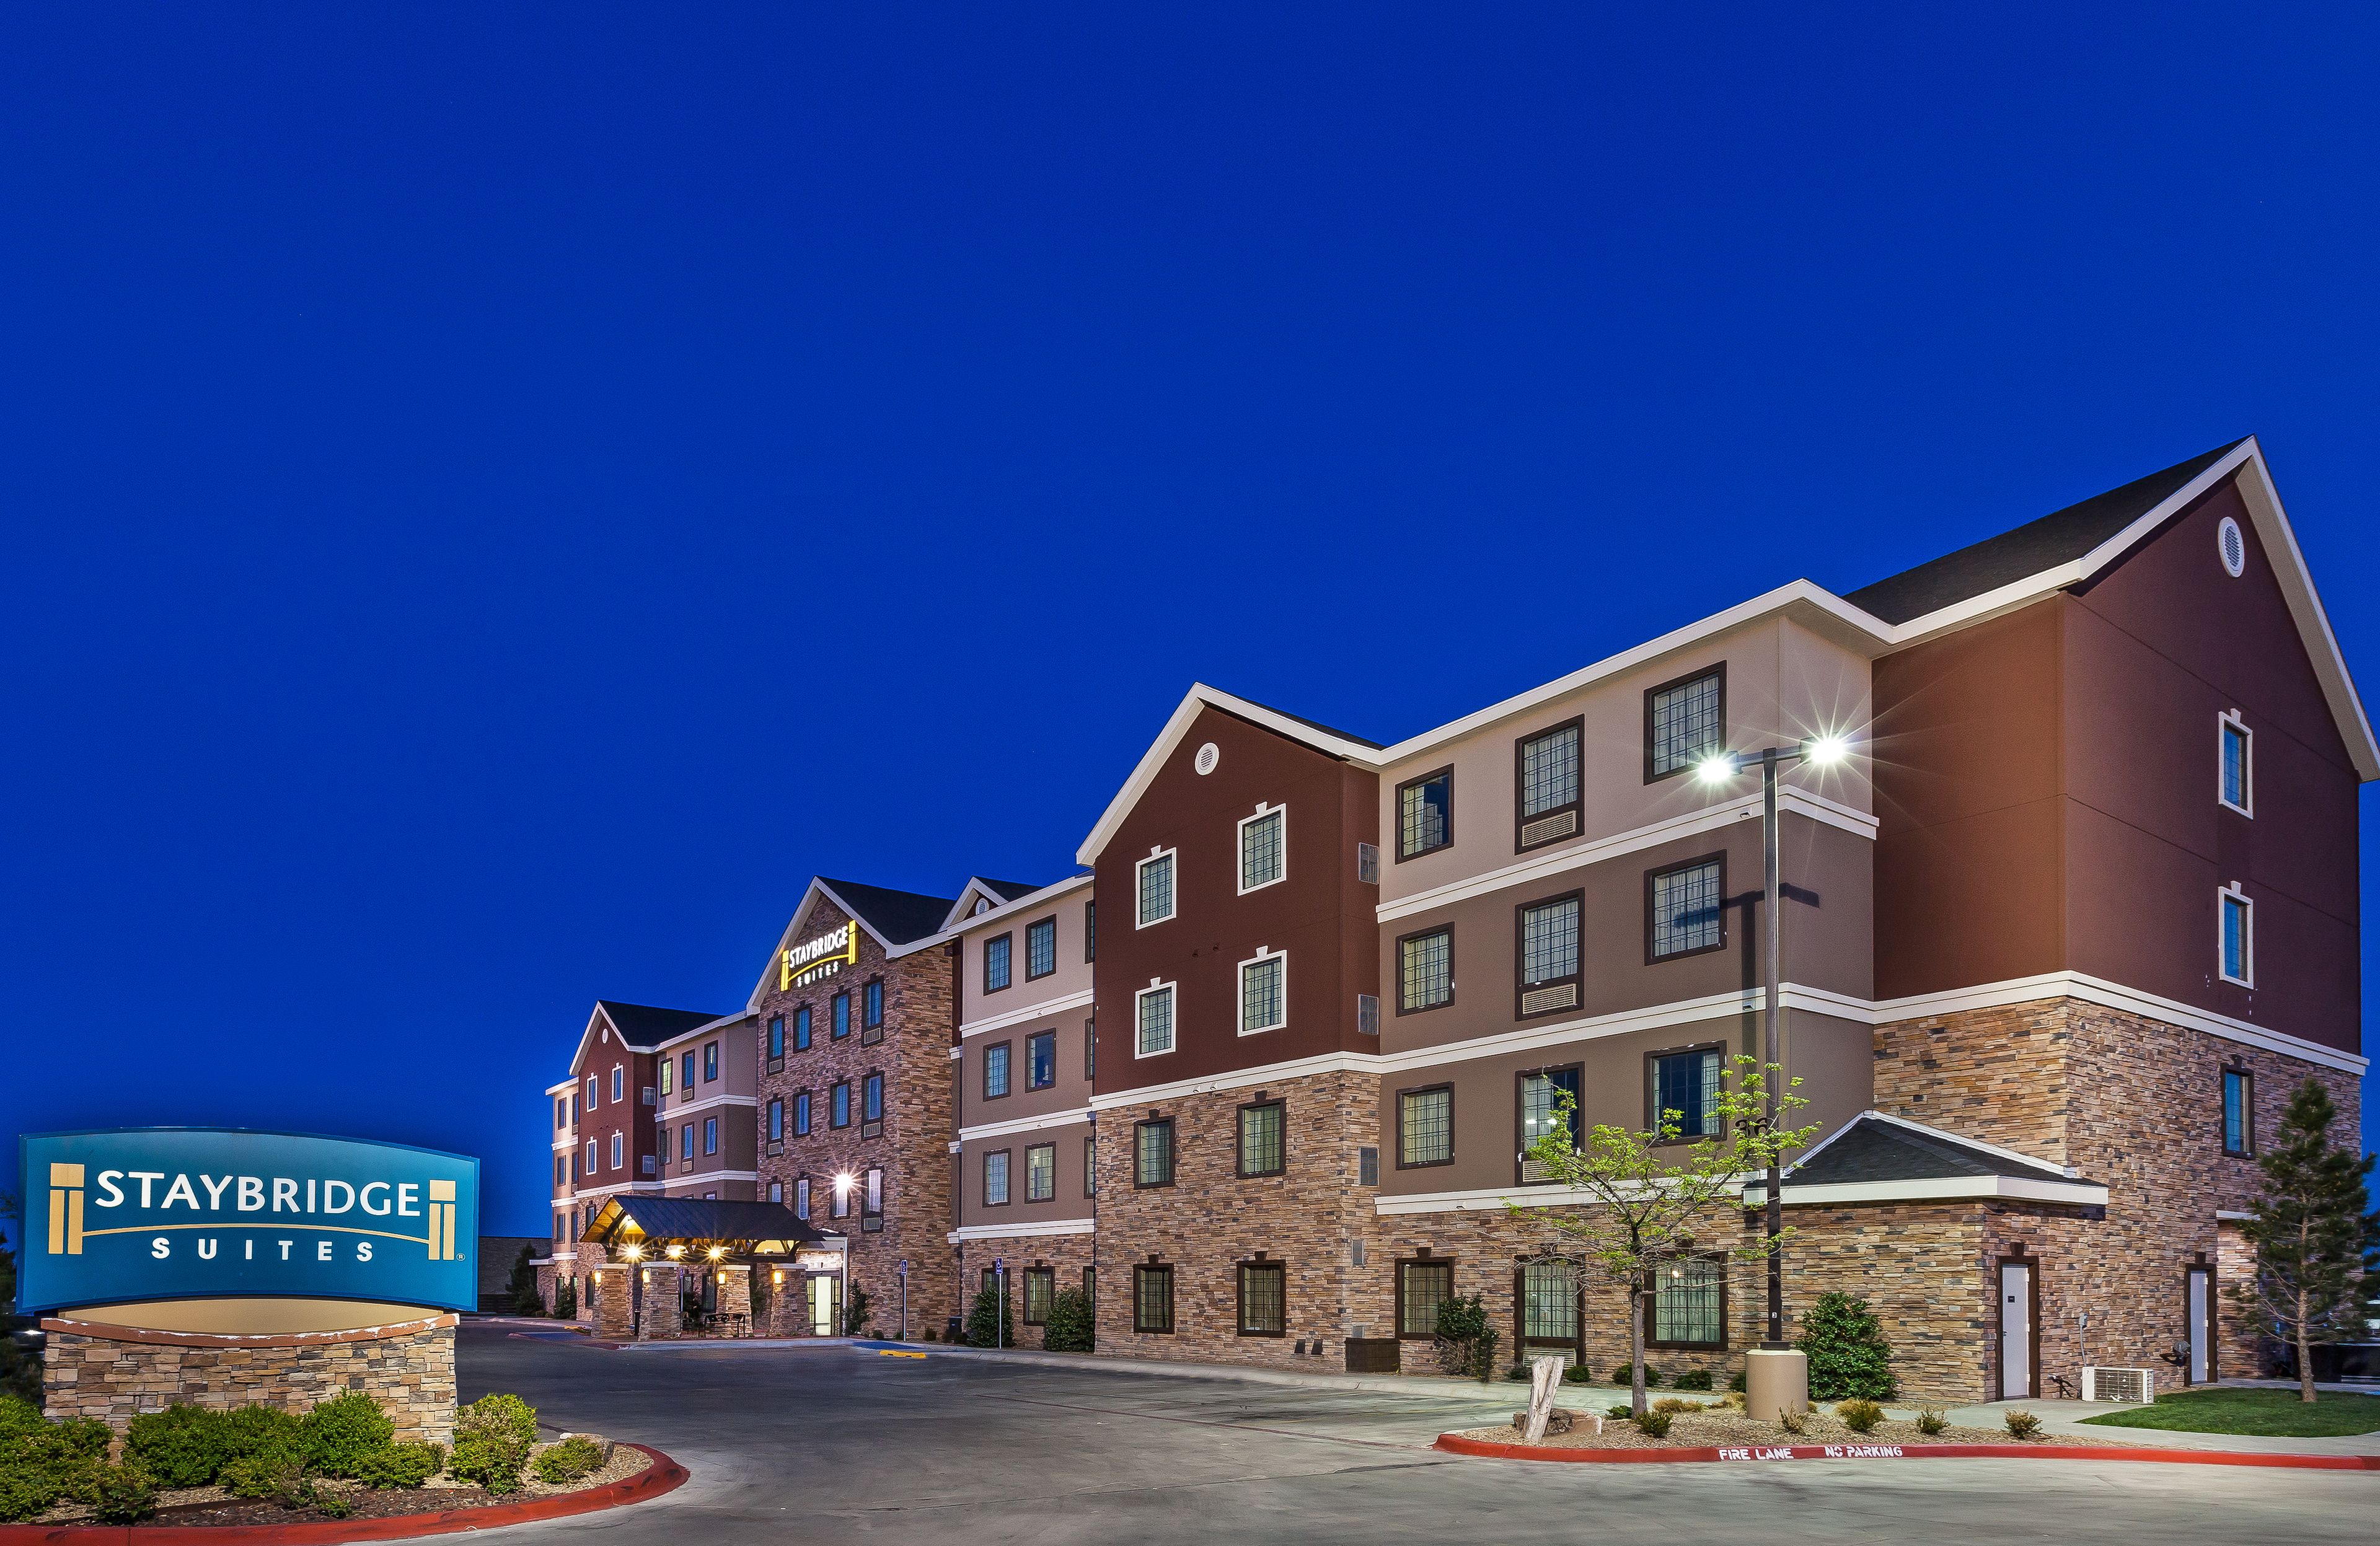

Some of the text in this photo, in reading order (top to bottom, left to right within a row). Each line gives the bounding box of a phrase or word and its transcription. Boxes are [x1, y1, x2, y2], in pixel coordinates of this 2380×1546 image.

[789, 926, 848, 968] STAYBRIDGE
[797, 961, 839, 987] SUITES
[95, 1170, 421, 1216] STAYBRIDGE
[151, 1237, 373, 1262] SUITES
[1719, 1447, 1794, 1460] FIRE LANE
[1825, 1446, 1903, 1457] NO PARKING
